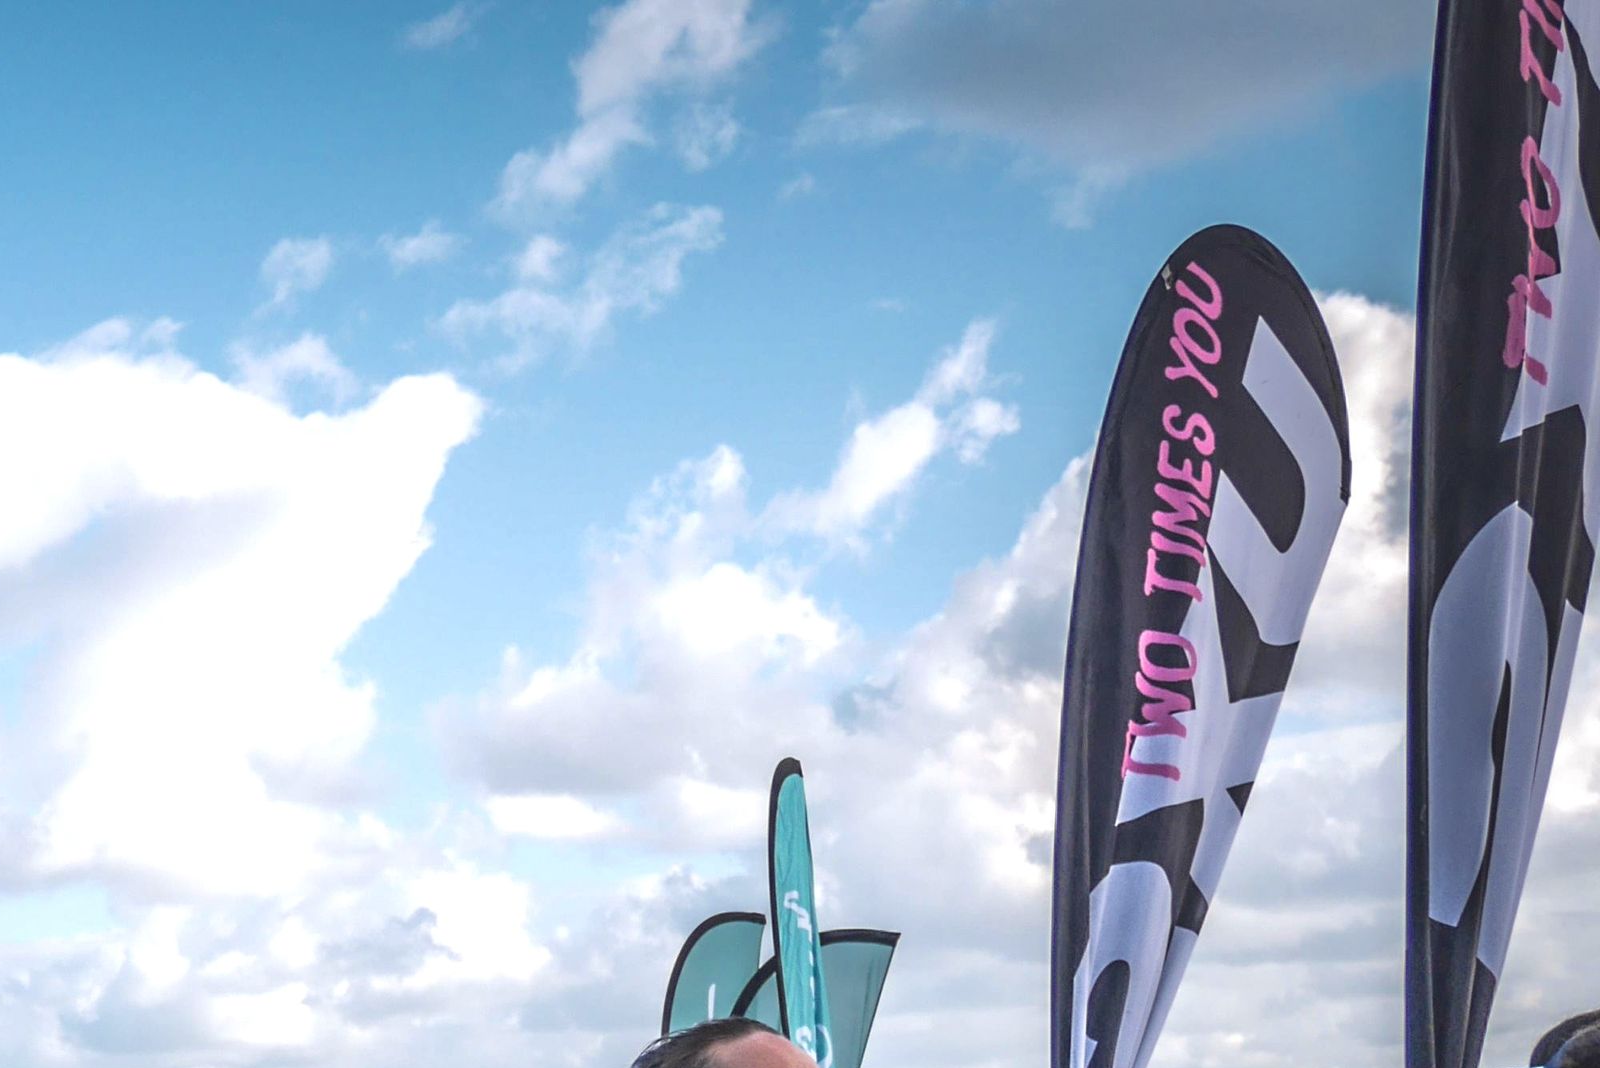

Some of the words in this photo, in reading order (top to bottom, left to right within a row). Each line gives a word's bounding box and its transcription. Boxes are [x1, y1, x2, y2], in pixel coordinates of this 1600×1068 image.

[1164, 261, 1224, 398] YOU
[1144, 403, 1216, 602] TIMES
[1121, 629, 1198, 783] TWO
